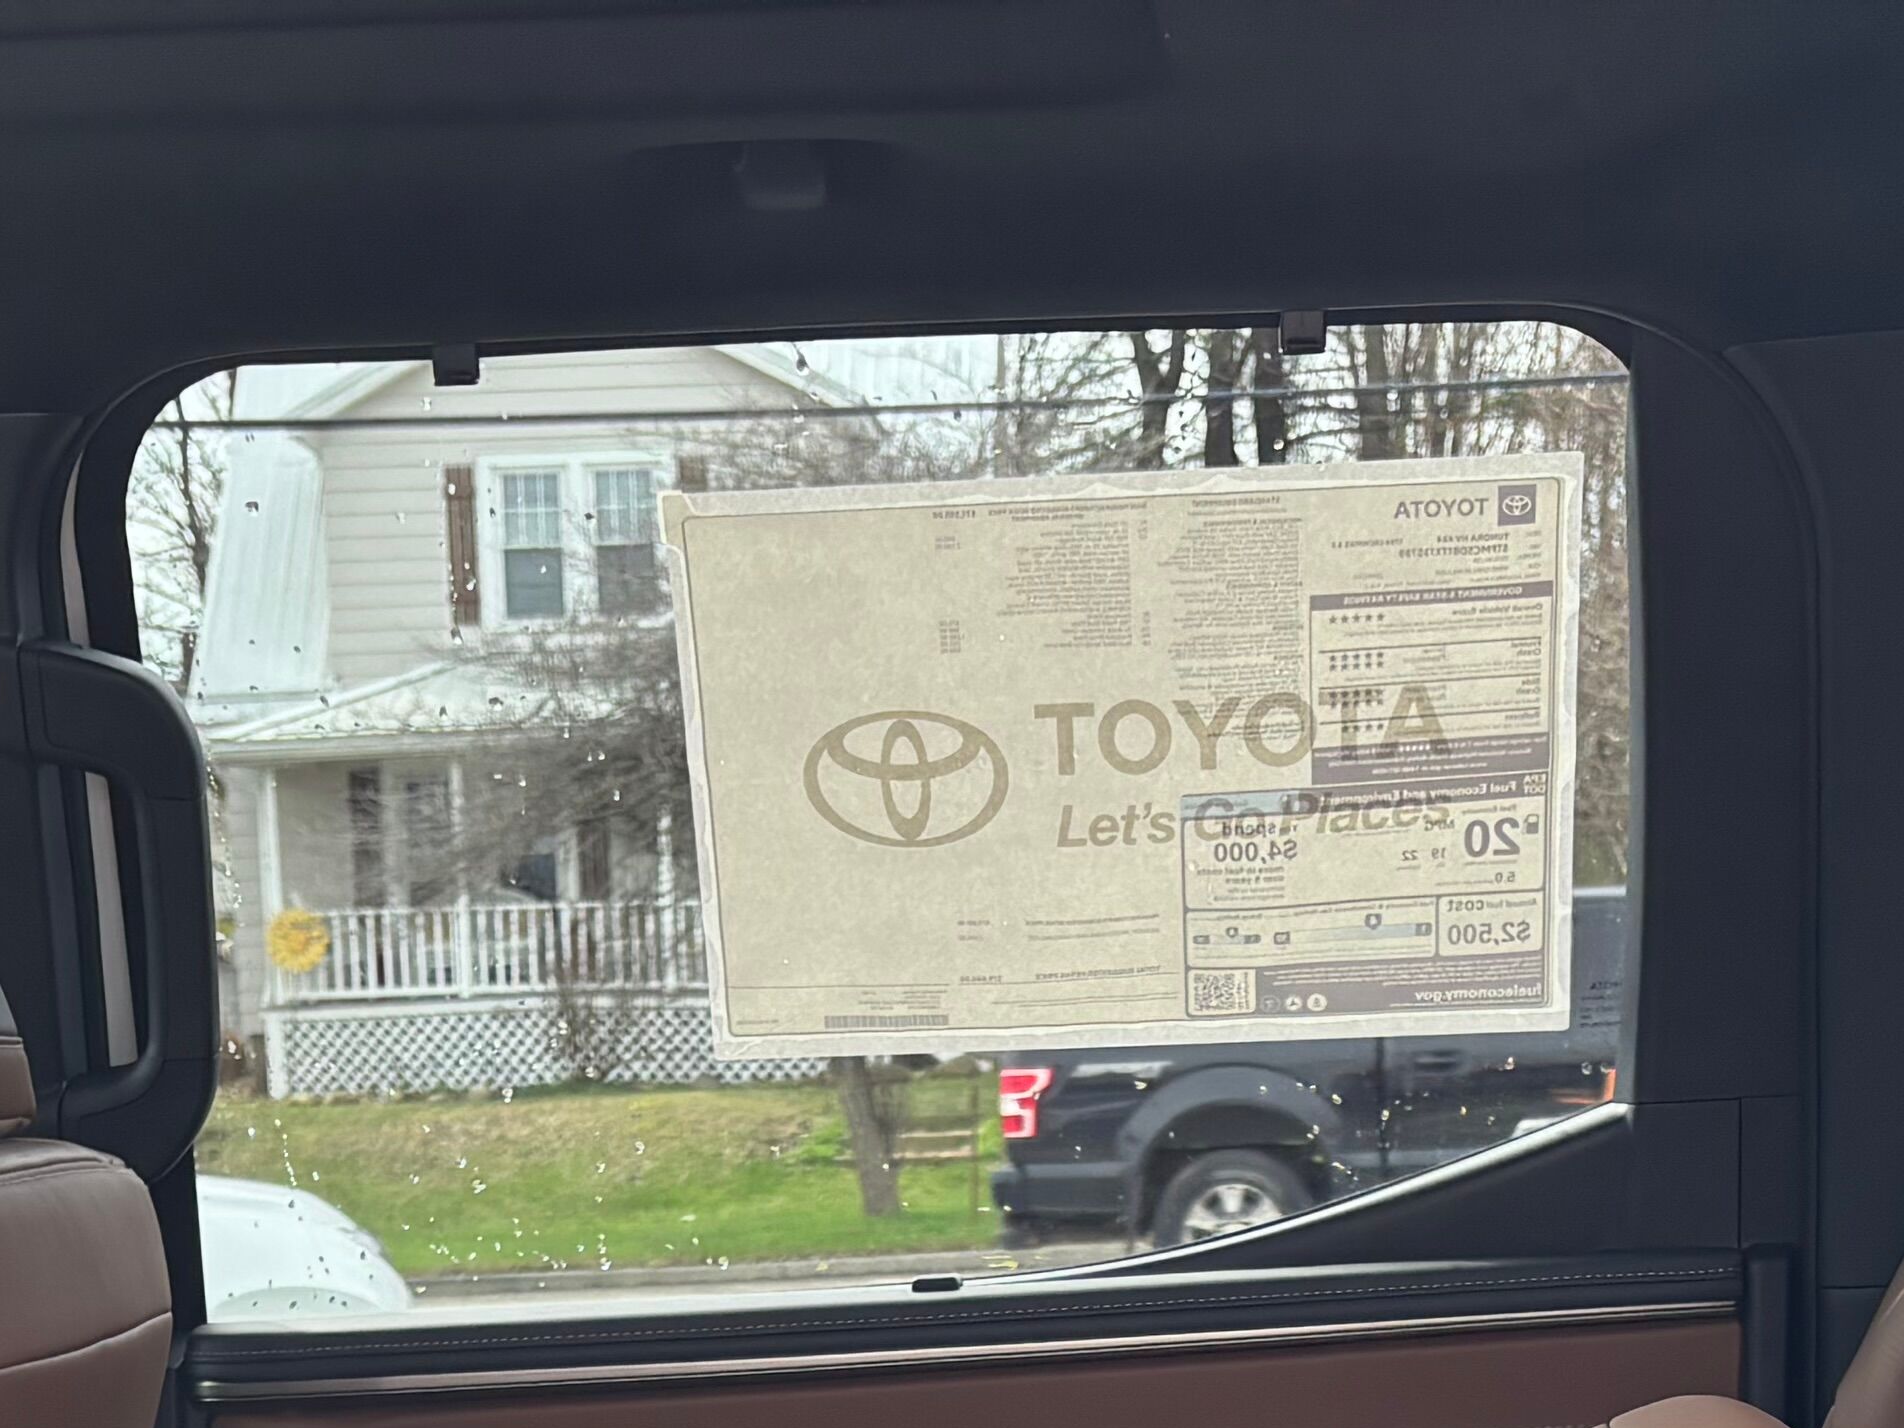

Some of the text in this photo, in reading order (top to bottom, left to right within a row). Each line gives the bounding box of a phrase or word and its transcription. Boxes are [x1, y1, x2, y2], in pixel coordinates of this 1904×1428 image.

[1033, 684, 1449, 776] TOYOTA
[1057, 783, 1452, 848] Let's Go Places
